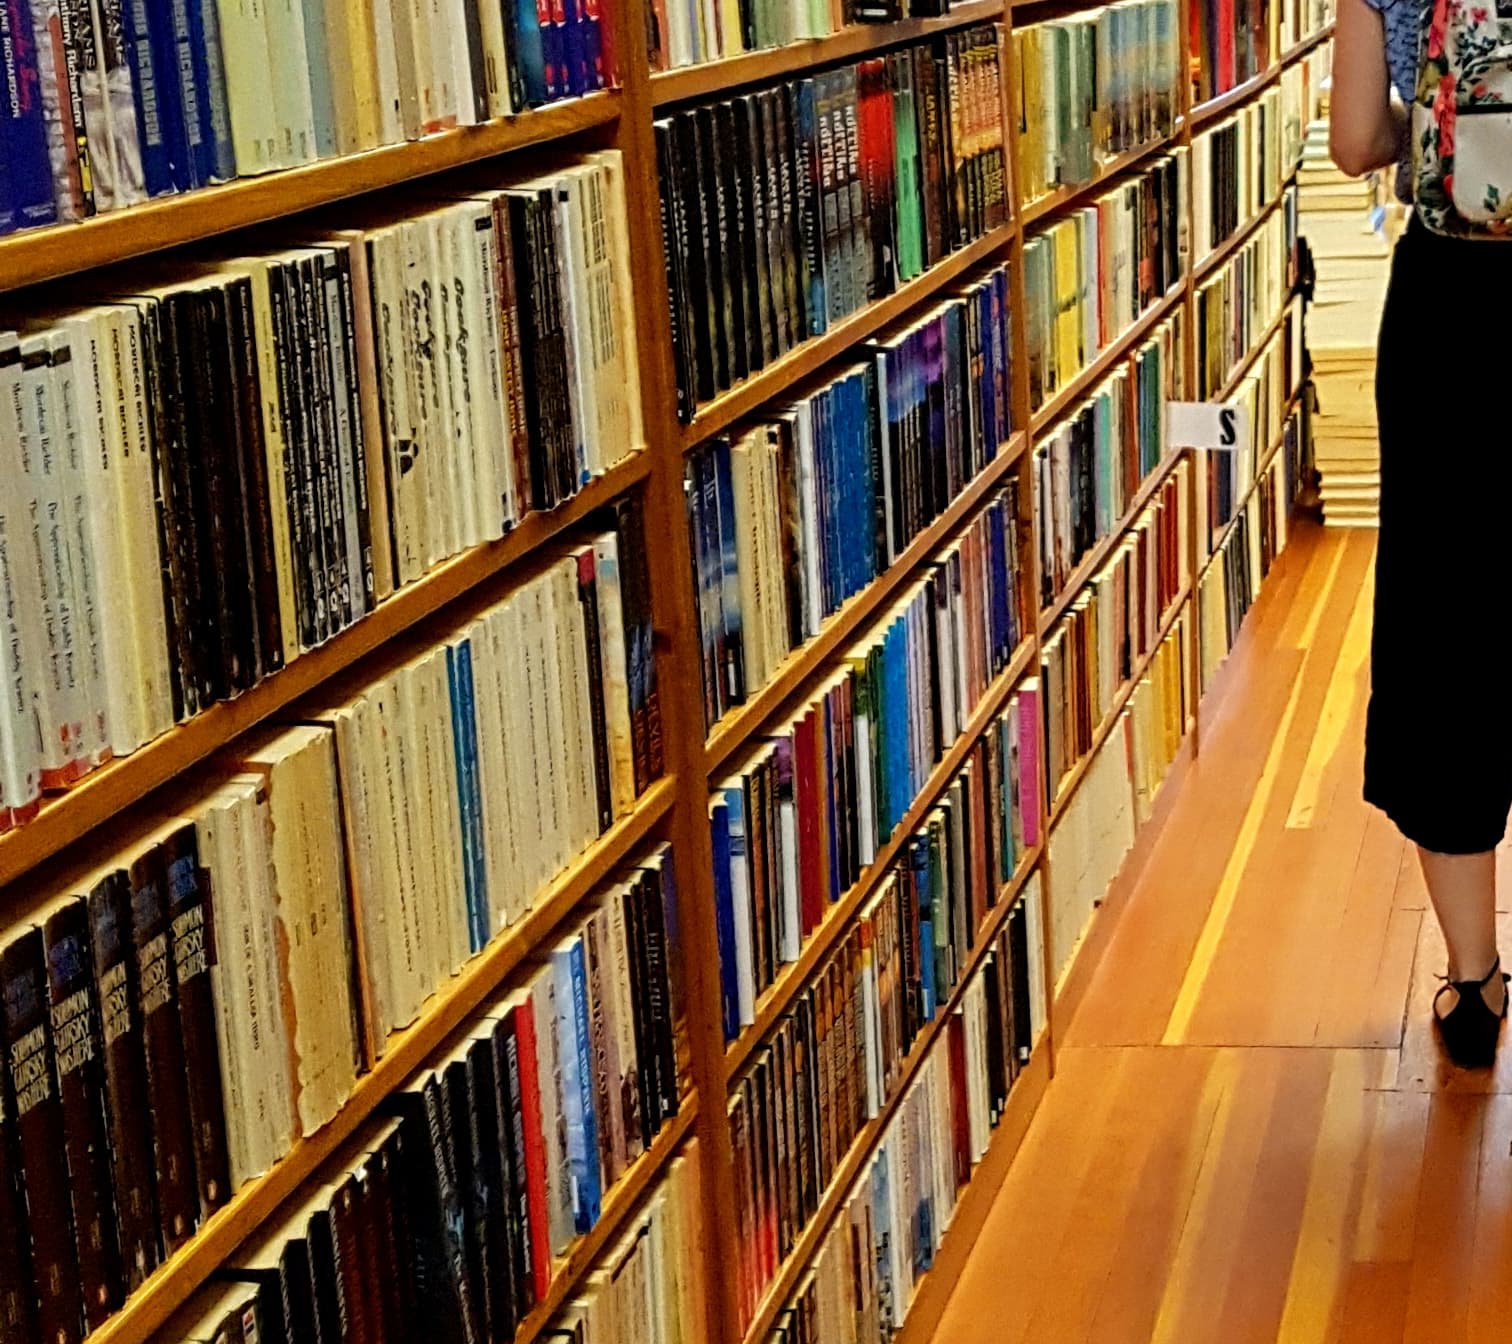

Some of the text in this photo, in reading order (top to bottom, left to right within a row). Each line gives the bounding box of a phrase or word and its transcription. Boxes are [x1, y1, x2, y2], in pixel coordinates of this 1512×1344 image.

[4, 37, 21, 119] RICHARDSON
[65, 49, 83, 129] Richardson
[1219, 408, 1236, 446] S
